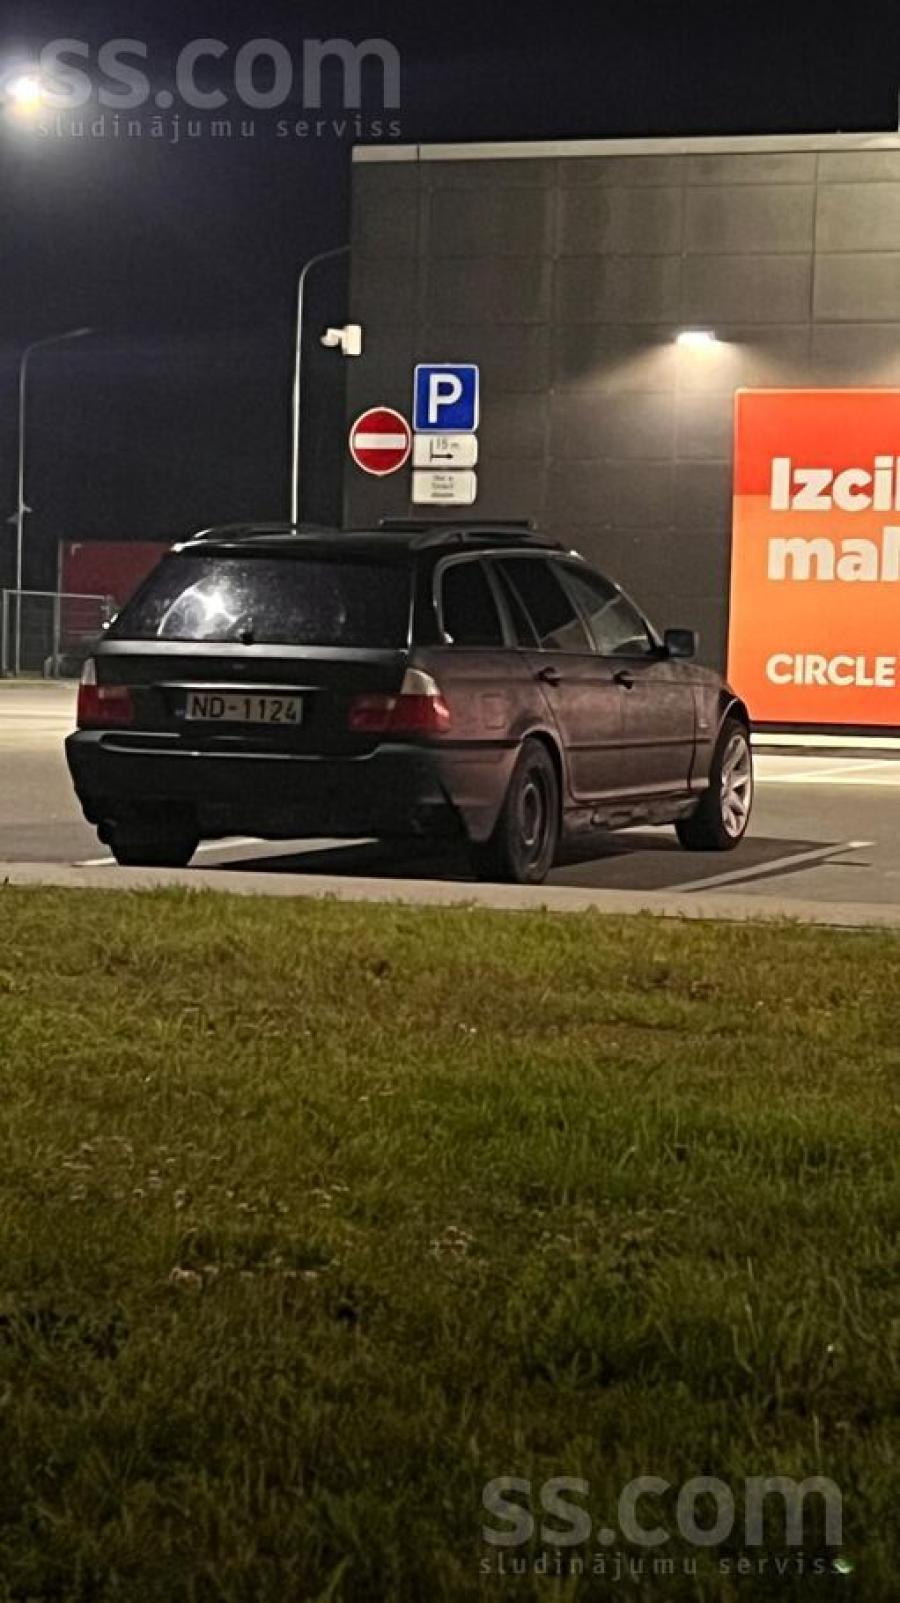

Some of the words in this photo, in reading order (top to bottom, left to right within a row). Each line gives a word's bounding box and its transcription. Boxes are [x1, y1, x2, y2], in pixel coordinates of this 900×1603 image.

[428, 373, 462, 423] P
[765, 653, 897, 688] CIRCLE
[191, 695, 297, 721] ND-1124
